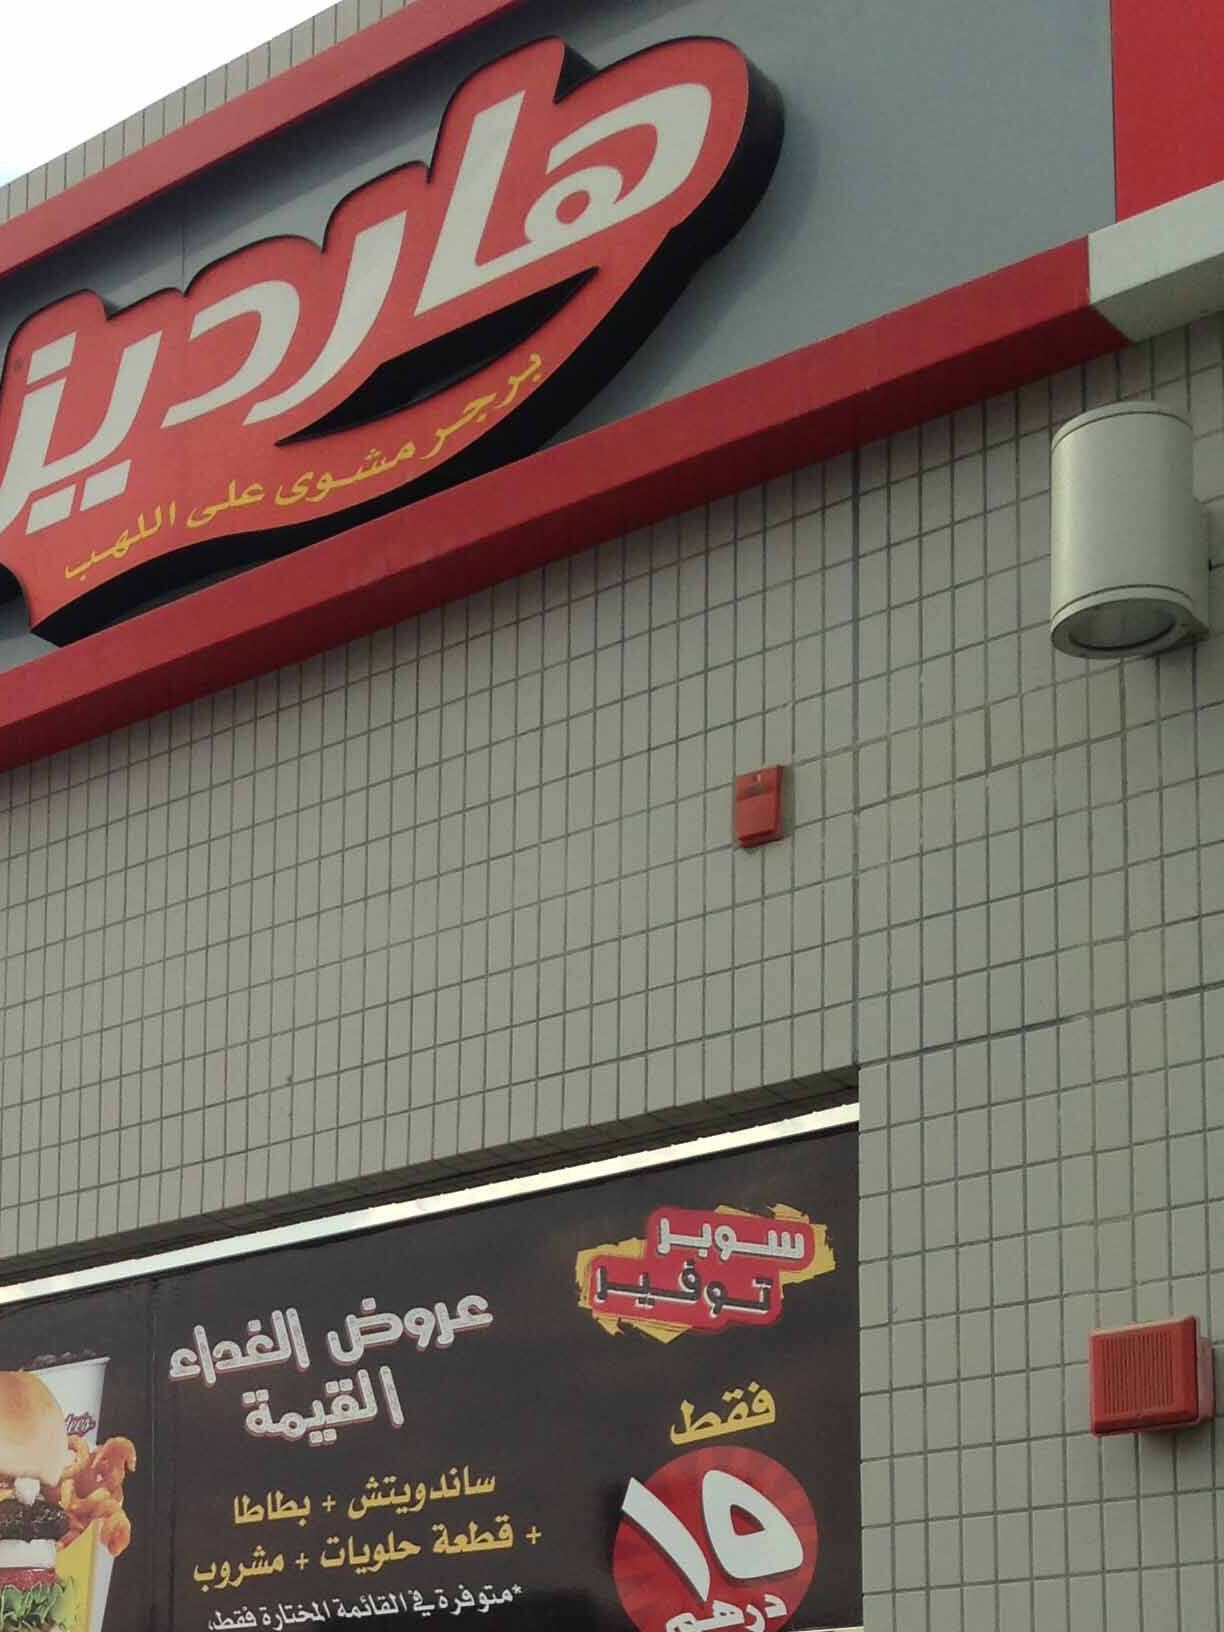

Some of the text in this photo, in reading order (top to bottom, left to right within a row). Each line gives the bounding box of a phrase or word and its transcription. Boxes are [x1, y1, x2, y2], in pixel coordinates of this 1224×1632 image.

[419, 352, 542, 461] برجر
[63, 499, 176, 580] اللهب
[656, 1217, 806, 1262] سوبر
[594, 1258, 774, 1320] توفير
[167, 1294, 494, 1388] عروض الغداء
[240, 1365, 406, 1447] القيمة
[669, 1380, 777, 1445] فقط
[233, 1465, 497, 1528] ساندويتش + بطاطا
[192, 1514, 542, 1592] + قطعة حلويات + مشروب
[621, 1469, 805, 1603] ١٥
[261, 1602, 331, 1632] المختارة
[336, 1592, 408, 1620] القائمة
[409, 1588, 436, 1617] في
